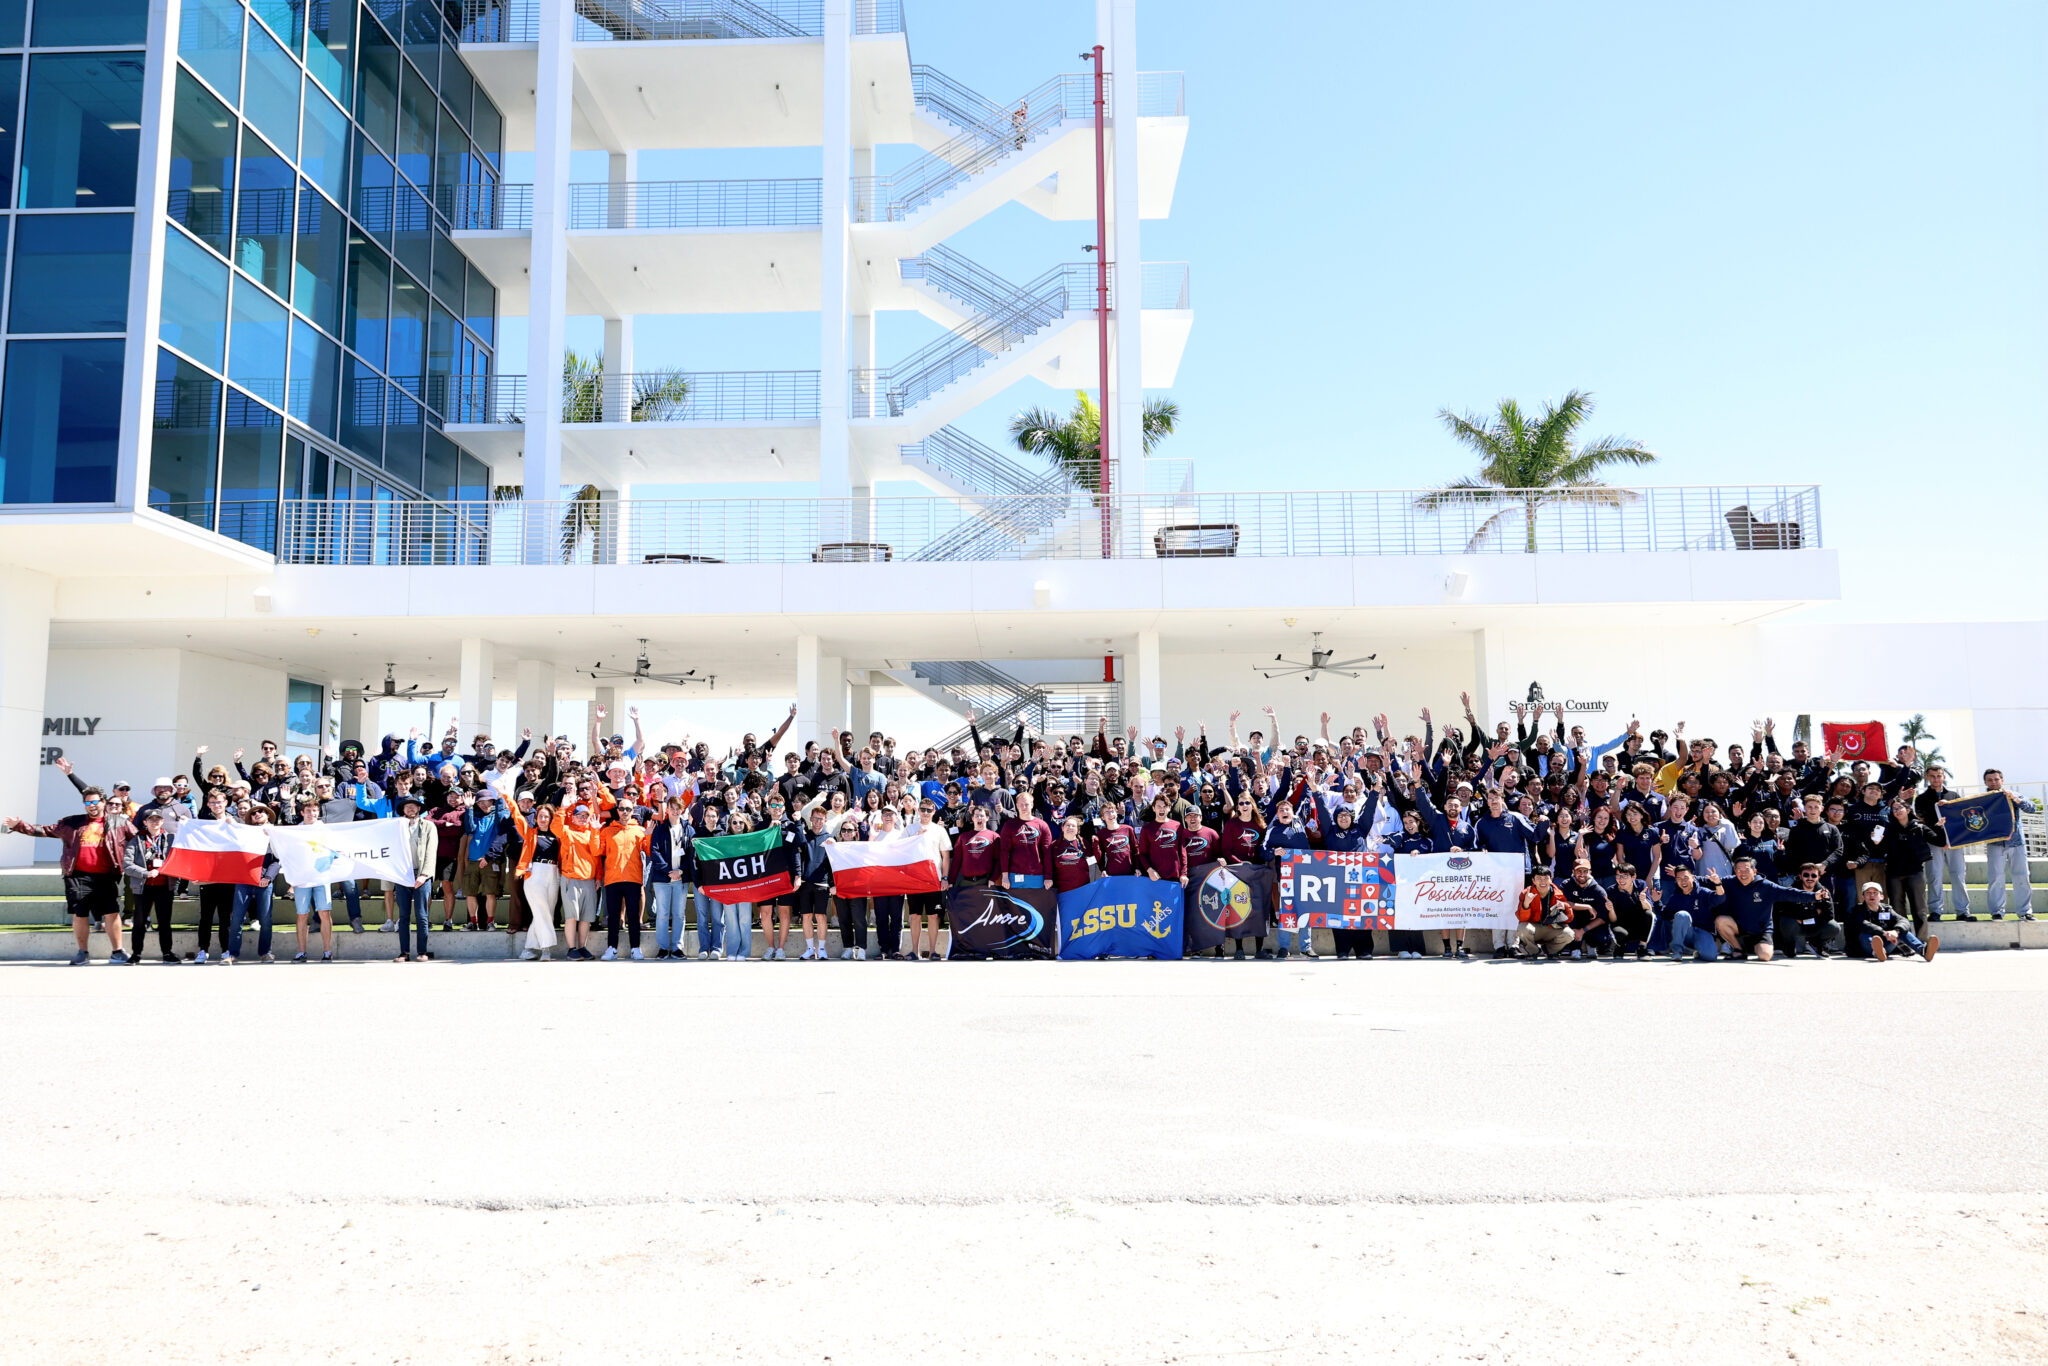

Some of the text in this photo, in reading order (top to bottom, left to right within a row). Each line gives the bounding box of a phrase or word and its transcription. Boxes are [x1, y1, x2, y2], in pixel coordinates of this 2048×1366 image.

[1565, 700, 1609, 712] County
[42, 717, 101, 736] MILY
[719, 854, 766, 880] AGH
[1430, 875, 1472, 883] CELEBRATE
[1300, 874, 1336, 903] R1
[1414, 880, 1506, 905] Possibilities
[958, 898, 1027, 934] Amore
[1069, 903, 1137, 941] LSSU
